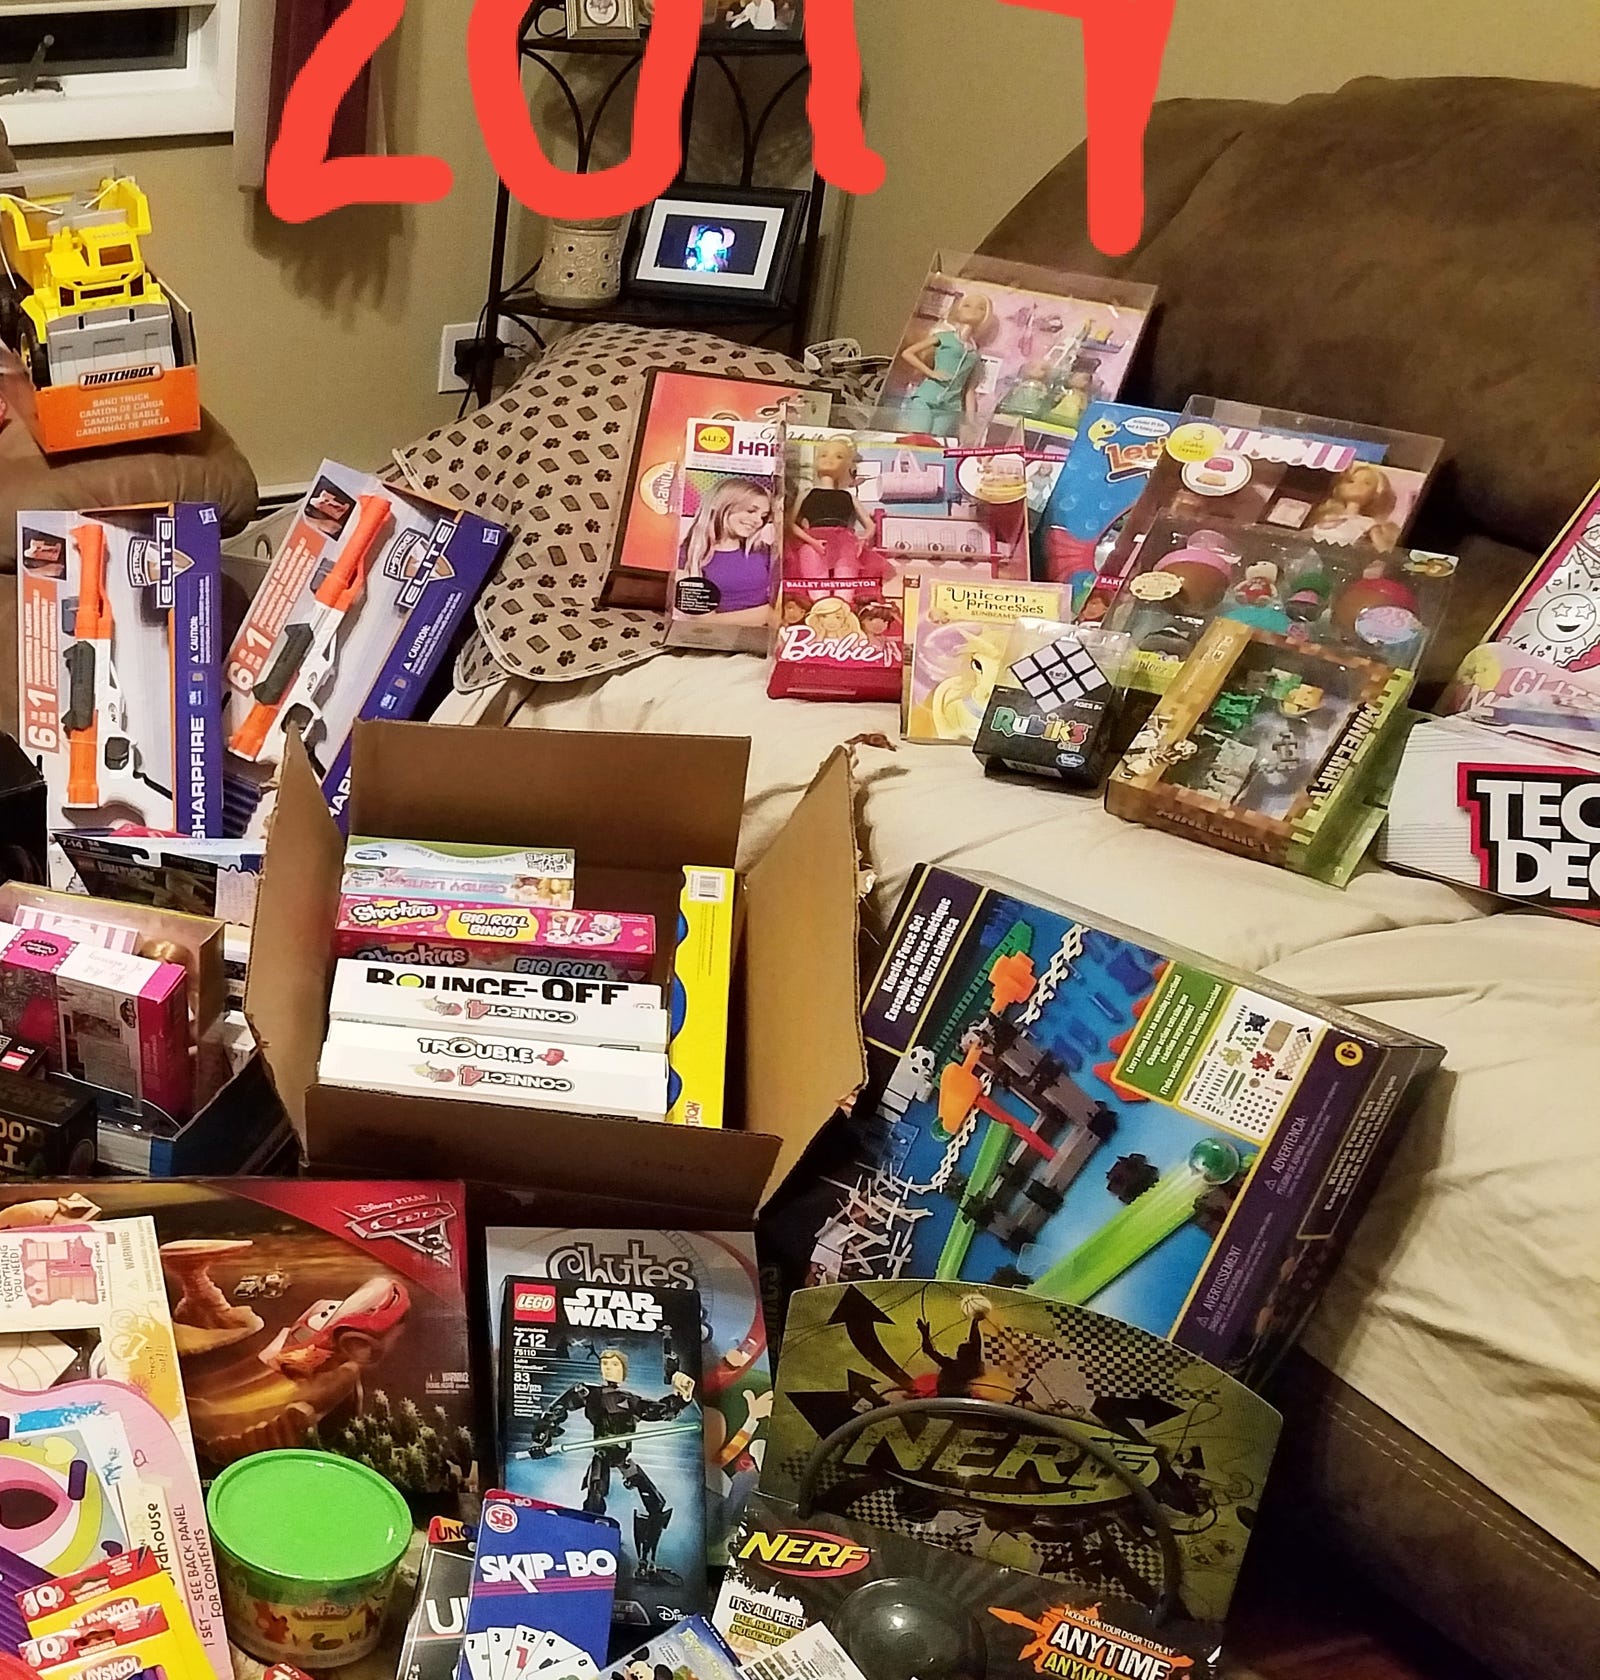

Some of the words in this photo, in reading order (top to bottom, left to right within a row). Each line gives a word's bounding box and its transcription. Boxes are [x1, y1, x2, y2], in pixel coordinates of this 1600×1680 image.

[84, 366, 155, 386] MATCHBOX
[92, 397, 117, 408] SAND
[120, 393, 150, 403] TRUCK
[134, 400, 164, 410] CARGA
[132, 409, 160, 418] SABLE
[142, 416, 170, 427] AREIA
[700, 435, 726, 444] ALEX
[161, 521, 173, 605] ELITE
[404, 524, 454, 605] ELITE
[787, 580, 818, 589] BALLET
[821, 580, 876, 589] INSTRUCTOR
[946, 587, 1026, 603] Unicorn
[966, 600, 1045, 615] Princesses
[190, 616, 199, 651] CAUTION:
[407, 623, 431, 659] CAUTION:
[782, 626, 883, 662] Barbie
[991, 707, 1090, 744] Rubik's
[1309, 703, 1383, 800] MINECRAFT
[191, 717, 205, 838] SHARPFIRE
[1156, 809, 1271, 852] MINECRAFT
[1497, 840, 1600, 900] DE
[351, 901, 437, 922] Shopkins
[458, 912, 486, 925] BIG
[486, 914, 529, 928] ROLL
[469, 924, 518, 938] BINGO
[882, 974, 916, 1022] Ensemble
[919, 894, 954, 942] cinétique
[917, 953, 942, 985] fuerza
[930, 915, 960, 957] cinética
[516, 959, 554, 976] BIG
[556, 961, 607, 979] ROLL
[880, 957, 907, 993] Kinetic
[896, 931, 918, 959] Force
[465, 999, 491, 1020] 4
[489, 1003, 578, 1024] CONNECT
[416, 1035, 537, 1064] TROUBLE
[457, 1064, 484, 1088] 4
[483, 1070, 574, 1092] CONNECT
[354, 1201, 393, 1214] Disney
[394, 1193, 429, 1205] PIXAR
[0, 1244, 13, 1302] EVERYTHING
[546, 1239, 696, 1290] Chutes
[14, 1277, 22, 1299] YOU
[517, 1293, 555, 1312] LEGO
[563, 1287, 663, 1314] STAR
[563, 1305, 664, 1332] WARS
[513, 1333, 547, 1348] 7-12
[513, 1348, 537, 1357] 75110
[513, 1372, 531, 1383] 83
[513, 1382, 542, 1394] pcs/pzs
[841, 1417, 1128, 1486] NERF
[173, 1503, 191, 1541] PANEL
[489, 1508, 514, 1529] SB
[435, 1526, 473, 1541] UNO
[194, 1528, 217, 1590] CONTENTS
[738, 1530, 872, 1570] NERF
[185, 1548, 200, 1583] BACK
[479, 1549, 618, 1594] SKIP-BO
[192, 1581, 205, 1601] SEE
[211, 1596, 225, 1618] FOR
[730, 1596, 753, 1612] IT'S
[753, 1603, 774, 1620] ALL
[774, 1609, 807, 1630] HERE!
[199, 1617, 213, 1639] SET
[521, 1630, 536, 1643] 12
[1065, 1609, 1090, 1625] HOOKS
[1101, 1621, 1122, 1636] YOUR
[1121, 1629, 1143, 1644] DOOR
[1154, 1643, 1174, 1657] PLAY
[1050, 1622, 1173, 1680] ANYTIME
